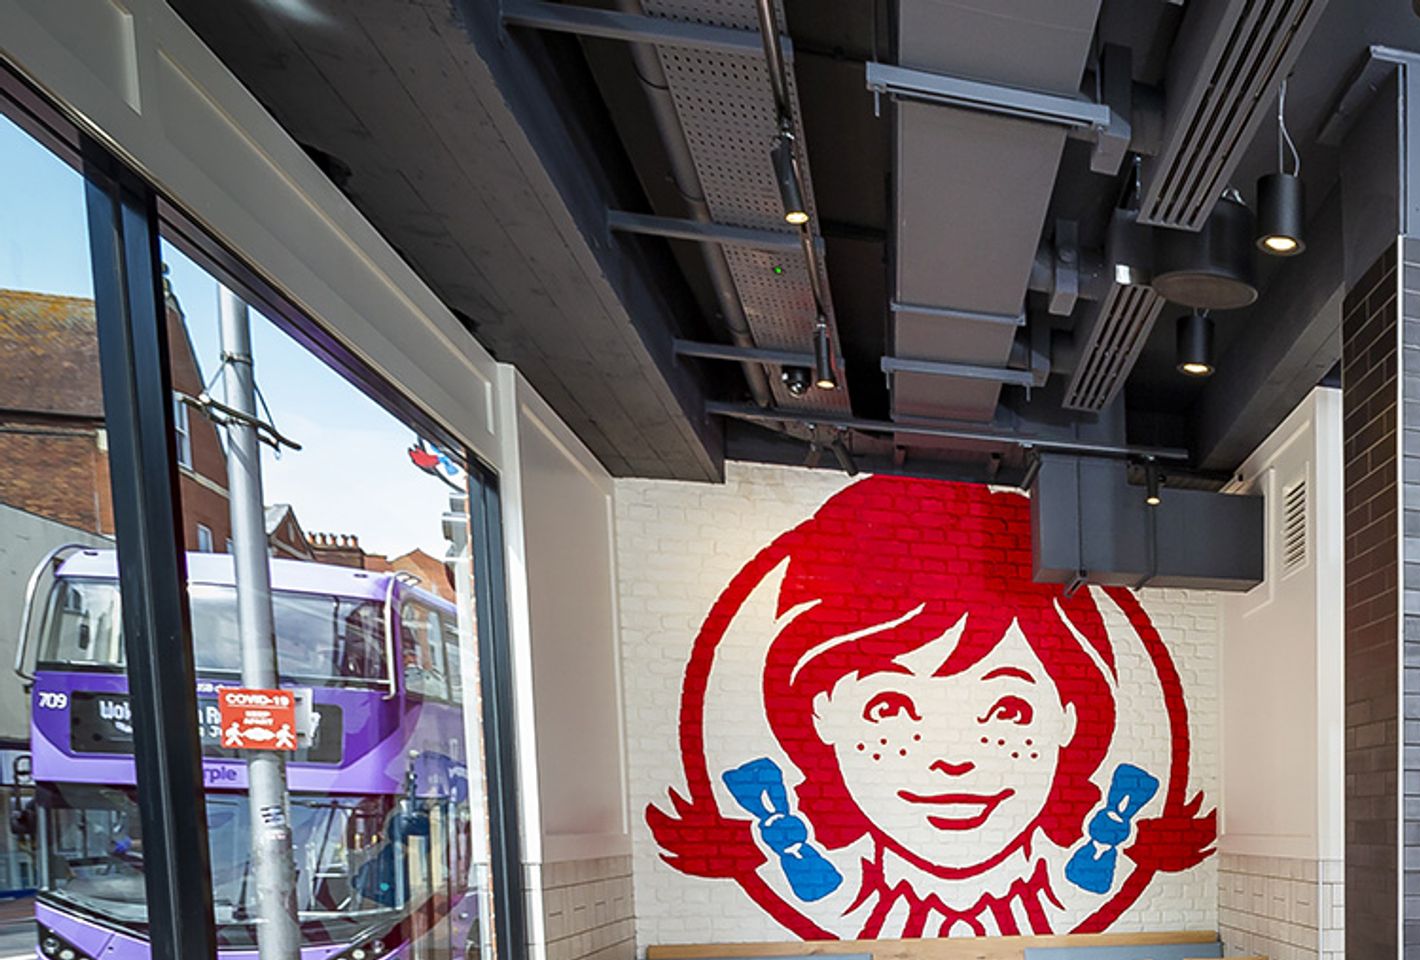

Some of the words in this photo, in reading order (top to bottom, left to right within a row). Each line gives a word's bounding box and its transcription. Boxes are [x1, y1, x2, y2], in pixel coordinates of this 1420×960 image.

[38, 691, 68, 710] 709
[225, 693, 290, 706] COVID-19
[204, 766, 237, 784] rple
